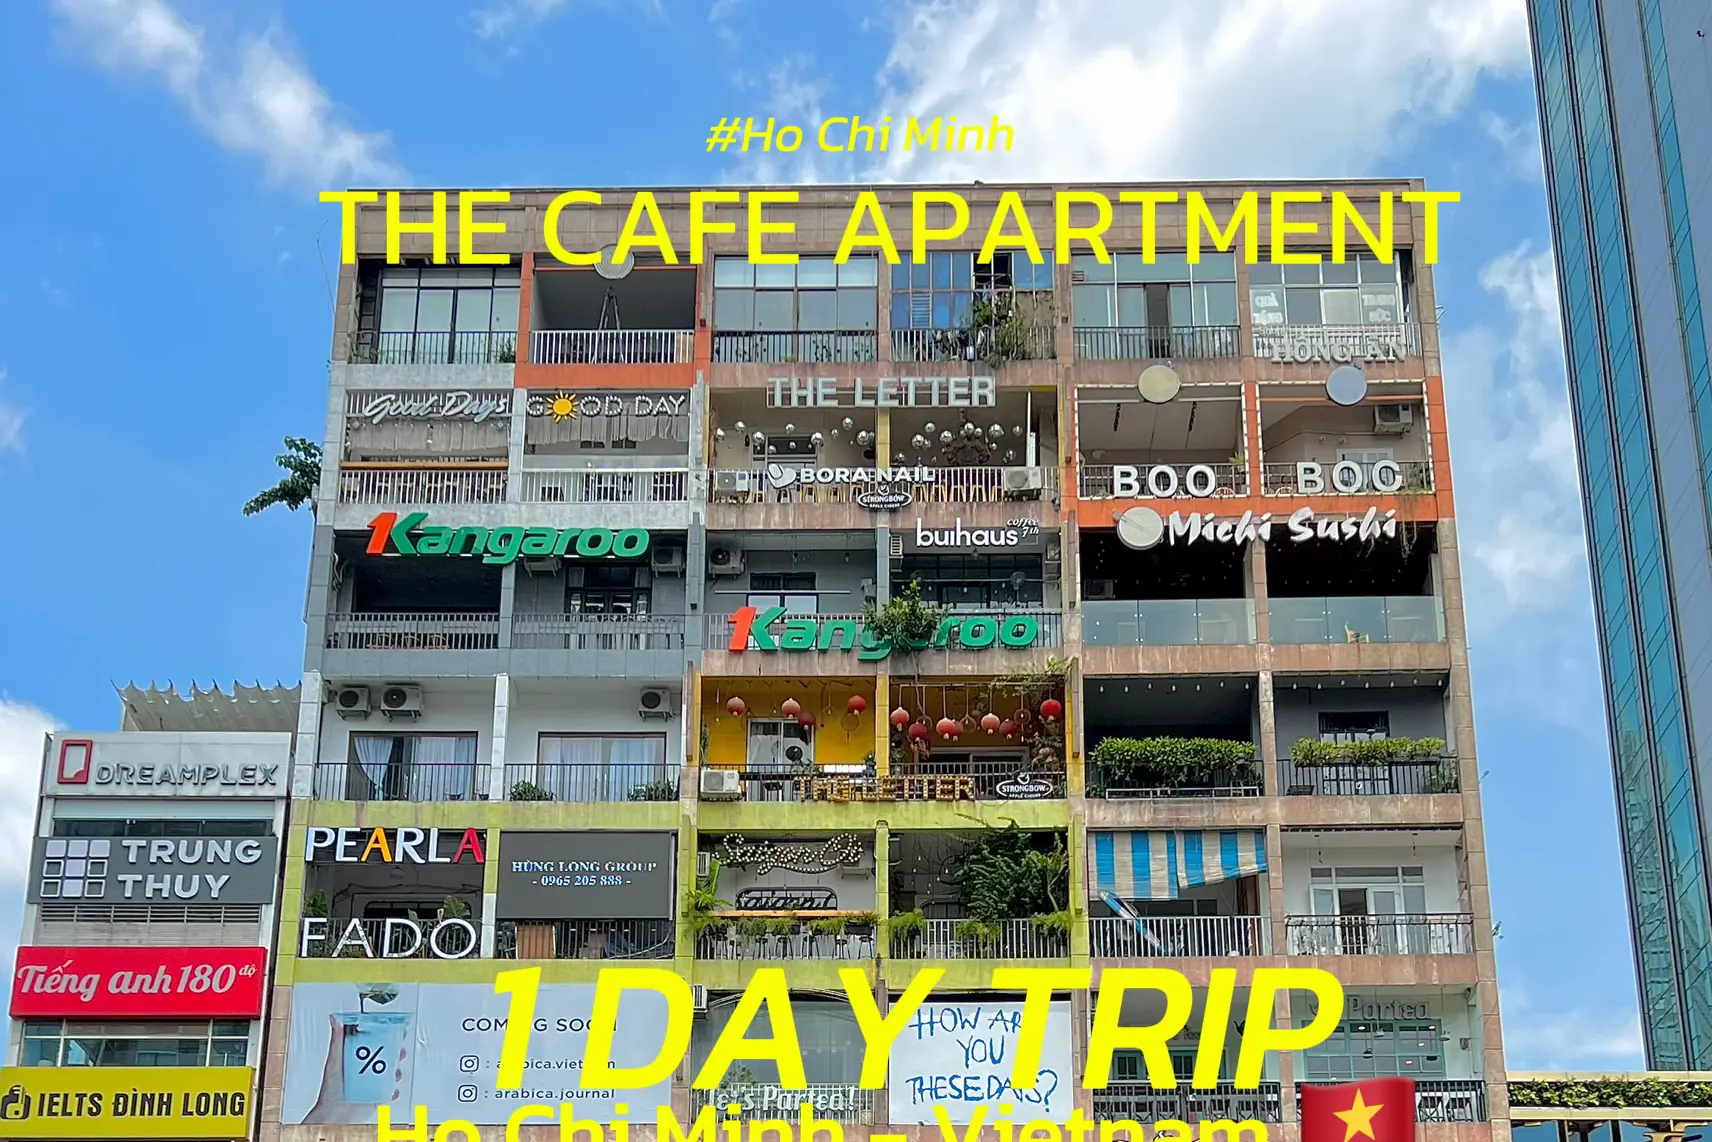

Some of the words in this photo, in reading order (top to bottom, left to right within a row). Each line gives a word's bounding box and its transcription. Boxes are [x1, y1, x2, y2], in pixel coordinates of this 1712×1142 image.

[635, 394, 685, 417] DAY
[767, 376, 838, 407] THE
[854, 375, 996, 407] LETTER
[363, 393, 438, 424] Good
[440, 390, 508, 423] Days
[799, 466, 870, 484] BORA
[876, 465, 936, 482] NAIL
[1113, 463, 1216, 498] BOO
[1006, 517, 1041, 528] coffee
[1021, 526, 1039, 538] 7th
[1168, 509, 1272, 547] Michi
[1287, 505, 1397, 544] Sushi
[726, 606, 1040, 664] 1Kangroo
[95, 762, 279, 786] DREAMPLEX
[121, 838, 263, 865] TRUNG
[305, 825, 485, 864] PEARLA
[511, 859, 555, 872] HÙNG
[559, 860, 600, 872] LONG
[604, 860, 657, 872] GROUP
[117, 873, 232, 899] THUY
[574, 875, 597, 886] 205
[301, 917, 478, 959] FADO
[17, 958, 101, 1002] Tiếng
[108, 964, 173, 994] anh
[175, 963, 237, 994] 180
[239, 963, 258, 978] độ
[461, 1017, 549, 1032] COMG
[908, 1006, 982, 1040] HOW
[987, 1009, 1022, 1033] AR
[956, 1034, 1006, 1069] YOU
[37, 1092, 104, 1118] IELTS
[112, 1087, 173, 1117] ĐÌNH
[181, 1091, 246, 1117] LONG
[494, 1087, 616, 1101] arabica.journal
